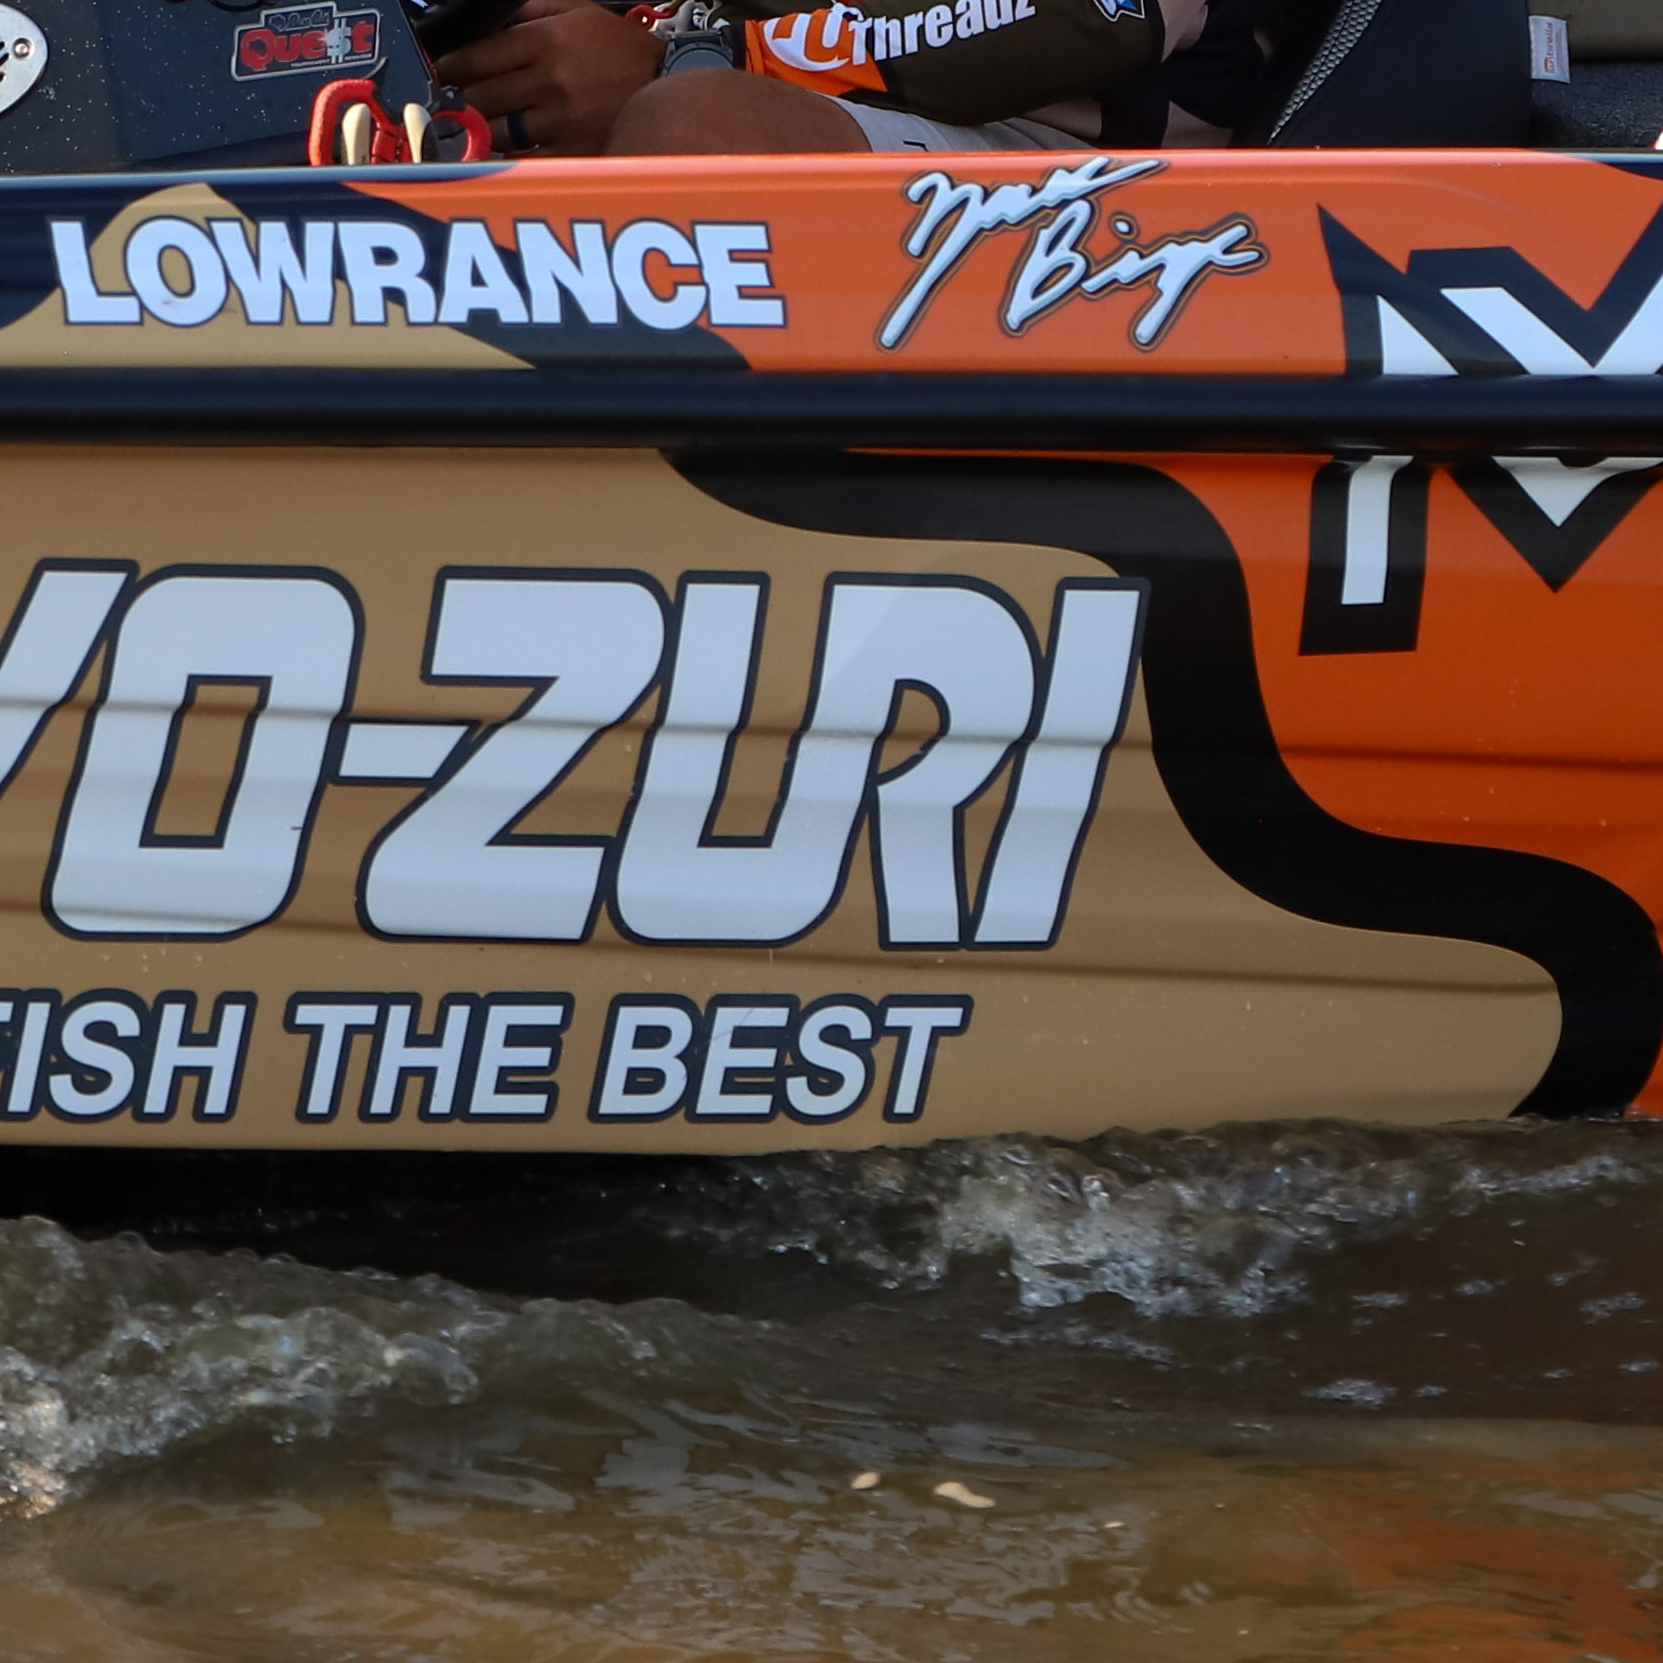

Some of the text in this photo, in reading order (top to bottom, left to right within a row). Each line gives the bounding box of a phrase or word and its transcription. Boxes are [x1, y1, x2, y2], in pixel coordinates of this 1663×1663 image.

[48, 216, 788, 334] LOWRANCE
[287, 991, 573, 1120] THE
[590, 993, 971, 1121] BEST
